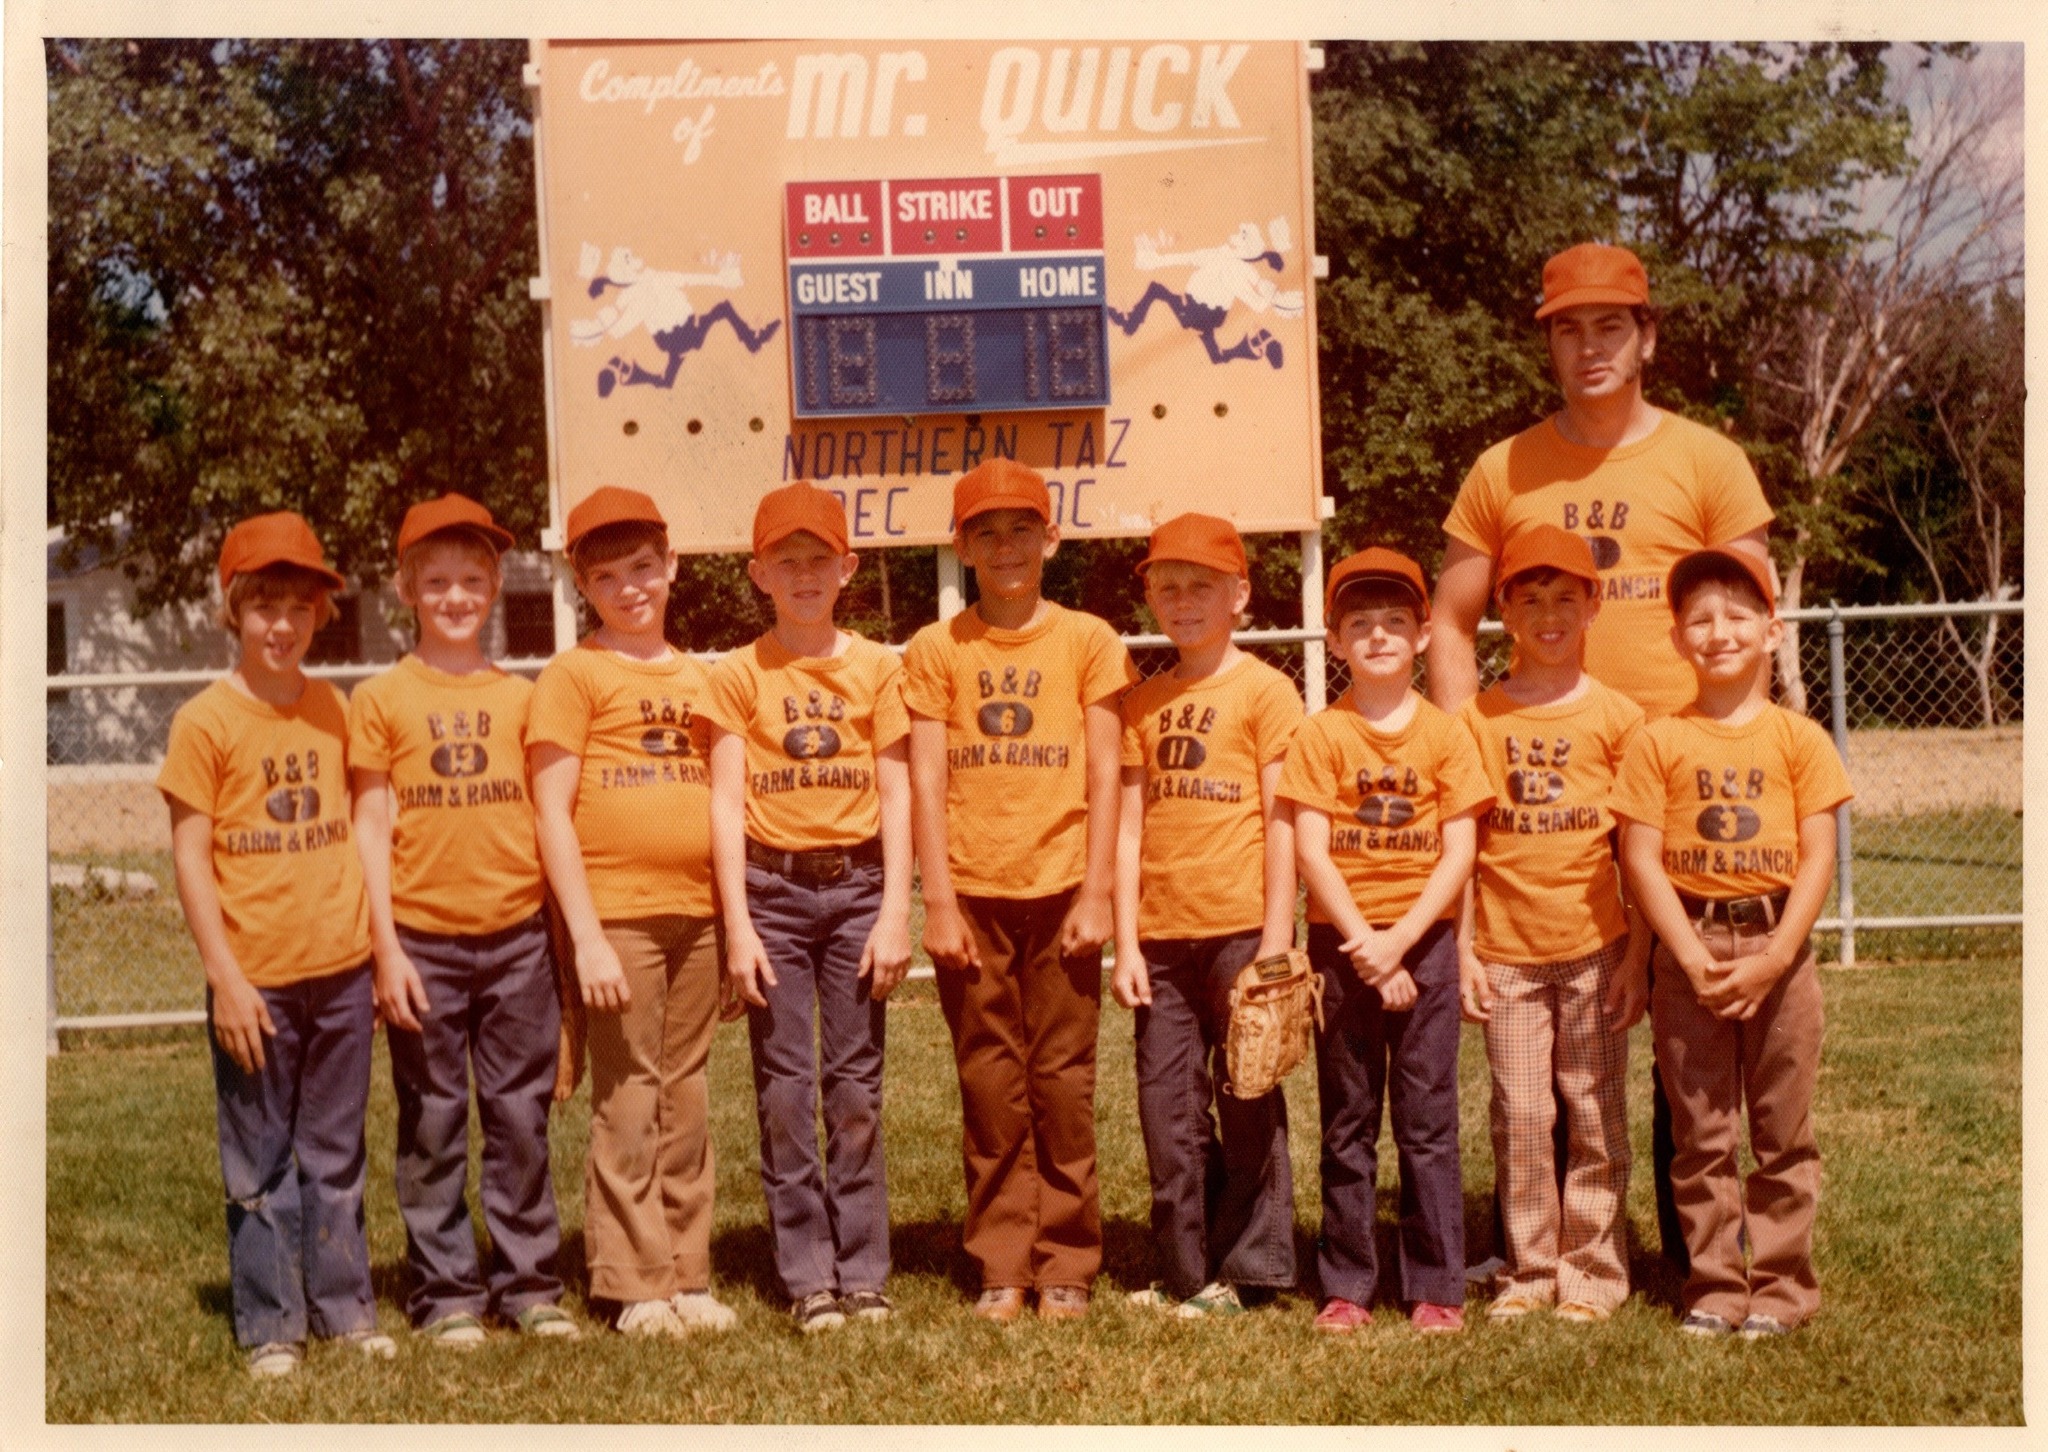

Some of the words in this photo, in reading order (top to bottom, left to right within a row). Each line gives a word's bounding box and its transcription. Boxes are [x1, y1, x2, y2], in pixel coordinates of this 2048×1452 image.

[579, 57, 784, 115] Compliments
[979, 44, 1254, 160] QUICK
[672, 103, 715, 165] of
[804, 193, 869, 224] BALL
[898, 189, 993, 222] STRIKE
[1028, 187, 1082, 217] OUT
[797, 272, 882, 304] GUEST
[924, 270, 973, 300] INN
[1020, 266, 1097, 298] HOME
[783, 423, 1018, 481] NORTHERN
[1048, 418, 1131, 470] TAZ
[838, 487, 909, 537] EC
[1564, 502, 1579, 530] B
[1586, 500, 1604, 529] &
[1609, 501, 1629, 530] B
[979, 670, 994, 699] B
[1001, 665, 1018, 694] &
[1023, 669, 1041, 697] B
[640, 699, 656, 724] B
[662, 697, 676, 723] &
[783, 695, 799, 724] B
[805, 689, 823, 719] &
[828, 695, 845, 722] B
[1000, 708, 1015, 733] 6
[1159, 708, 1173, 733] B
[1176, 703, 1195, 730] &
[1197, 706, 1216, 734] B
[428, 712, 446, 740] B
[454, 710, 471, 738] &
[477, 711, 491, 738] B
[989, 744, 1002, 766] &
[1005, 743, 1069, 769] RANCH
[1168, 740, 1188, 765] 11
[1506, 736, 1521, 765] B
[1528, 738, 1546, 767] &
[1552, 738, 1571, 767] B
[262, 757, 279, 787] B
[286, 753, 302, 784] &
[307, 750, 319, 779] B
[602, 764, 656, 789] FARM
[662, 763, 676, 783] &
[752, 768, 795, 794] FARM
[800, 764, 813, 787] &
[817, 764, 870, 790] RANCH
[1378, 765, 1397, 792] &
[1403, 767, 1418, 796] B
[1697, 768, 1713, 800] B
[1720, 766, 1738, 799] &
[1745, 768, 1764, 800] B
[449, 783, 465, 807] &
[467, 779, 523, 805] RANCH
[1164, 776, 1175, 799] &
[1178, 775, 1241, 802] RANCH
[292, 793, 305, 822] 7
[1519, 810, 1533, 834] &
[1537, 807, 1599, 834] RANCH
[228, 830, 281, 856] FARM
[287, 829, 301, 853] &
[305, 818, 348, 851] RANCH
[1367, 828, 1381, 850] &
[1718, 811, 1738, 840] 3
[1713, 849, 1728, 874] &
[1734, 848, 1793, 875] RANCH
